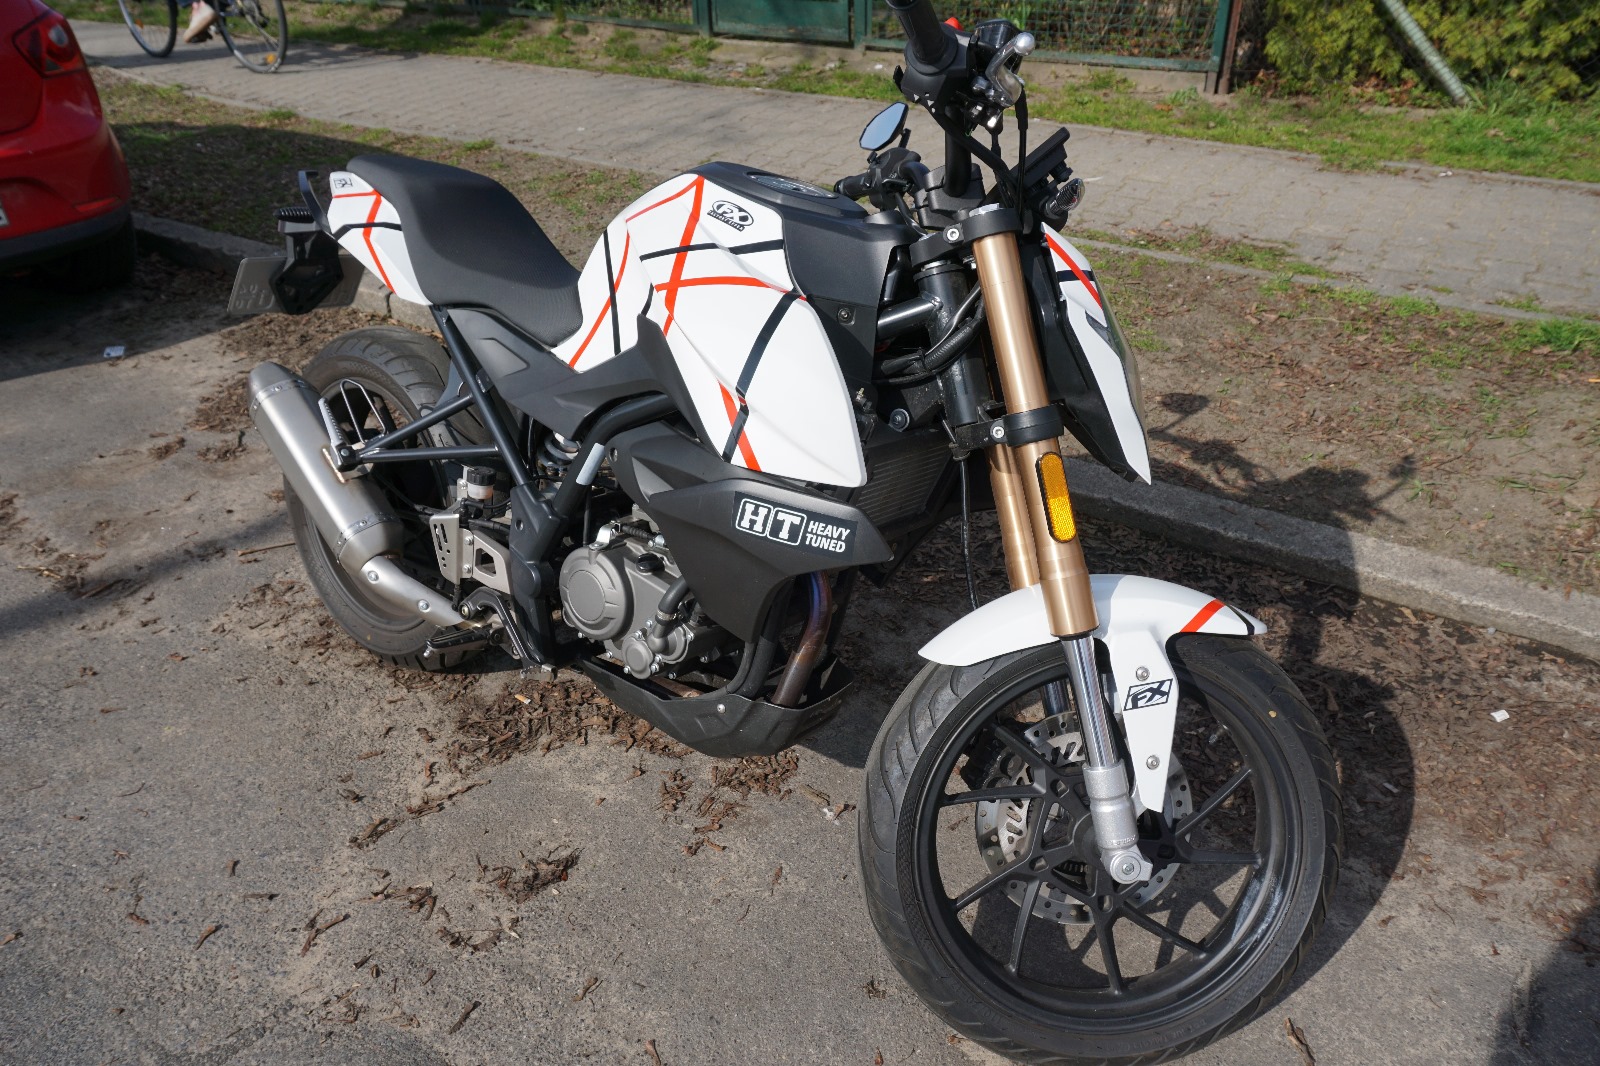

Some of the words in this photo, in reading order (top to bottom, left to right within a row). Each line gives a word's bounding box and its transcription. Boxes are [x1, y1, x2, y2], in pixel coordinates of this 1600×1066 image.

[713, 201, 752, 226] FX
[738, 501, 803, 542] HT
[807, 520, 851, 541] HEAVY
[805, 533, 846, 553] TUNED
[1129, 679, 1170, 710] FX
